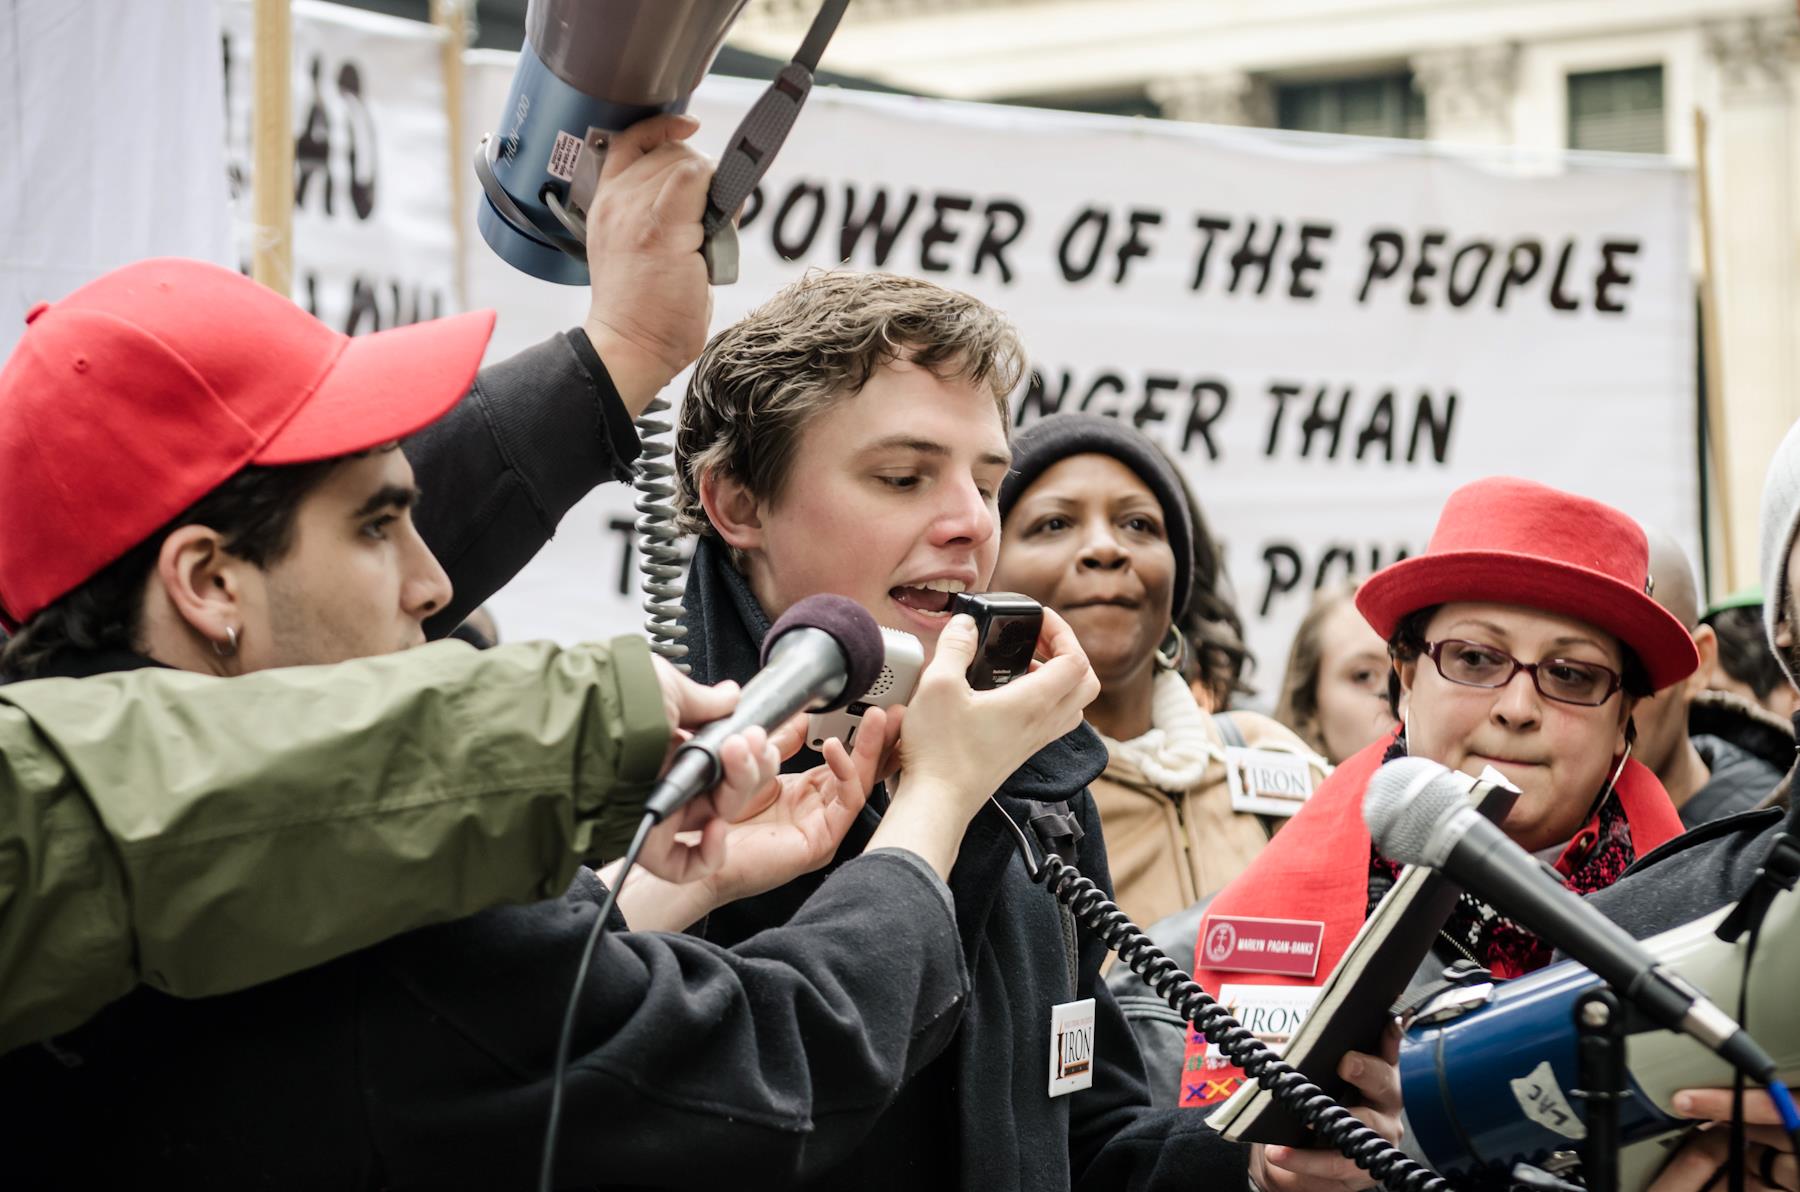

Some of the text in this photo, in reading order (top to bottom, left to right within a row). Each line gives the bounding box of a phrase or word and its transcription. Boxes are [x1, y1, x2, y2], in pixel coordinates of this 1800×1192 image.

[1058, 208, 1161, 284] OF
[1193, 217, 1332, 298] THE
[1359, 231, 1639, 312] PEOPLE
[1266, 386, 1457, 463] THAN
[1252, 767, 1306, 793] IRON
[1237, 938, 1314, 956] MARILYN PAGAN-BANKS
[1242, 1007, 1310, 1033] IRON
[1064, 1027, 1092, 1064] IRON
